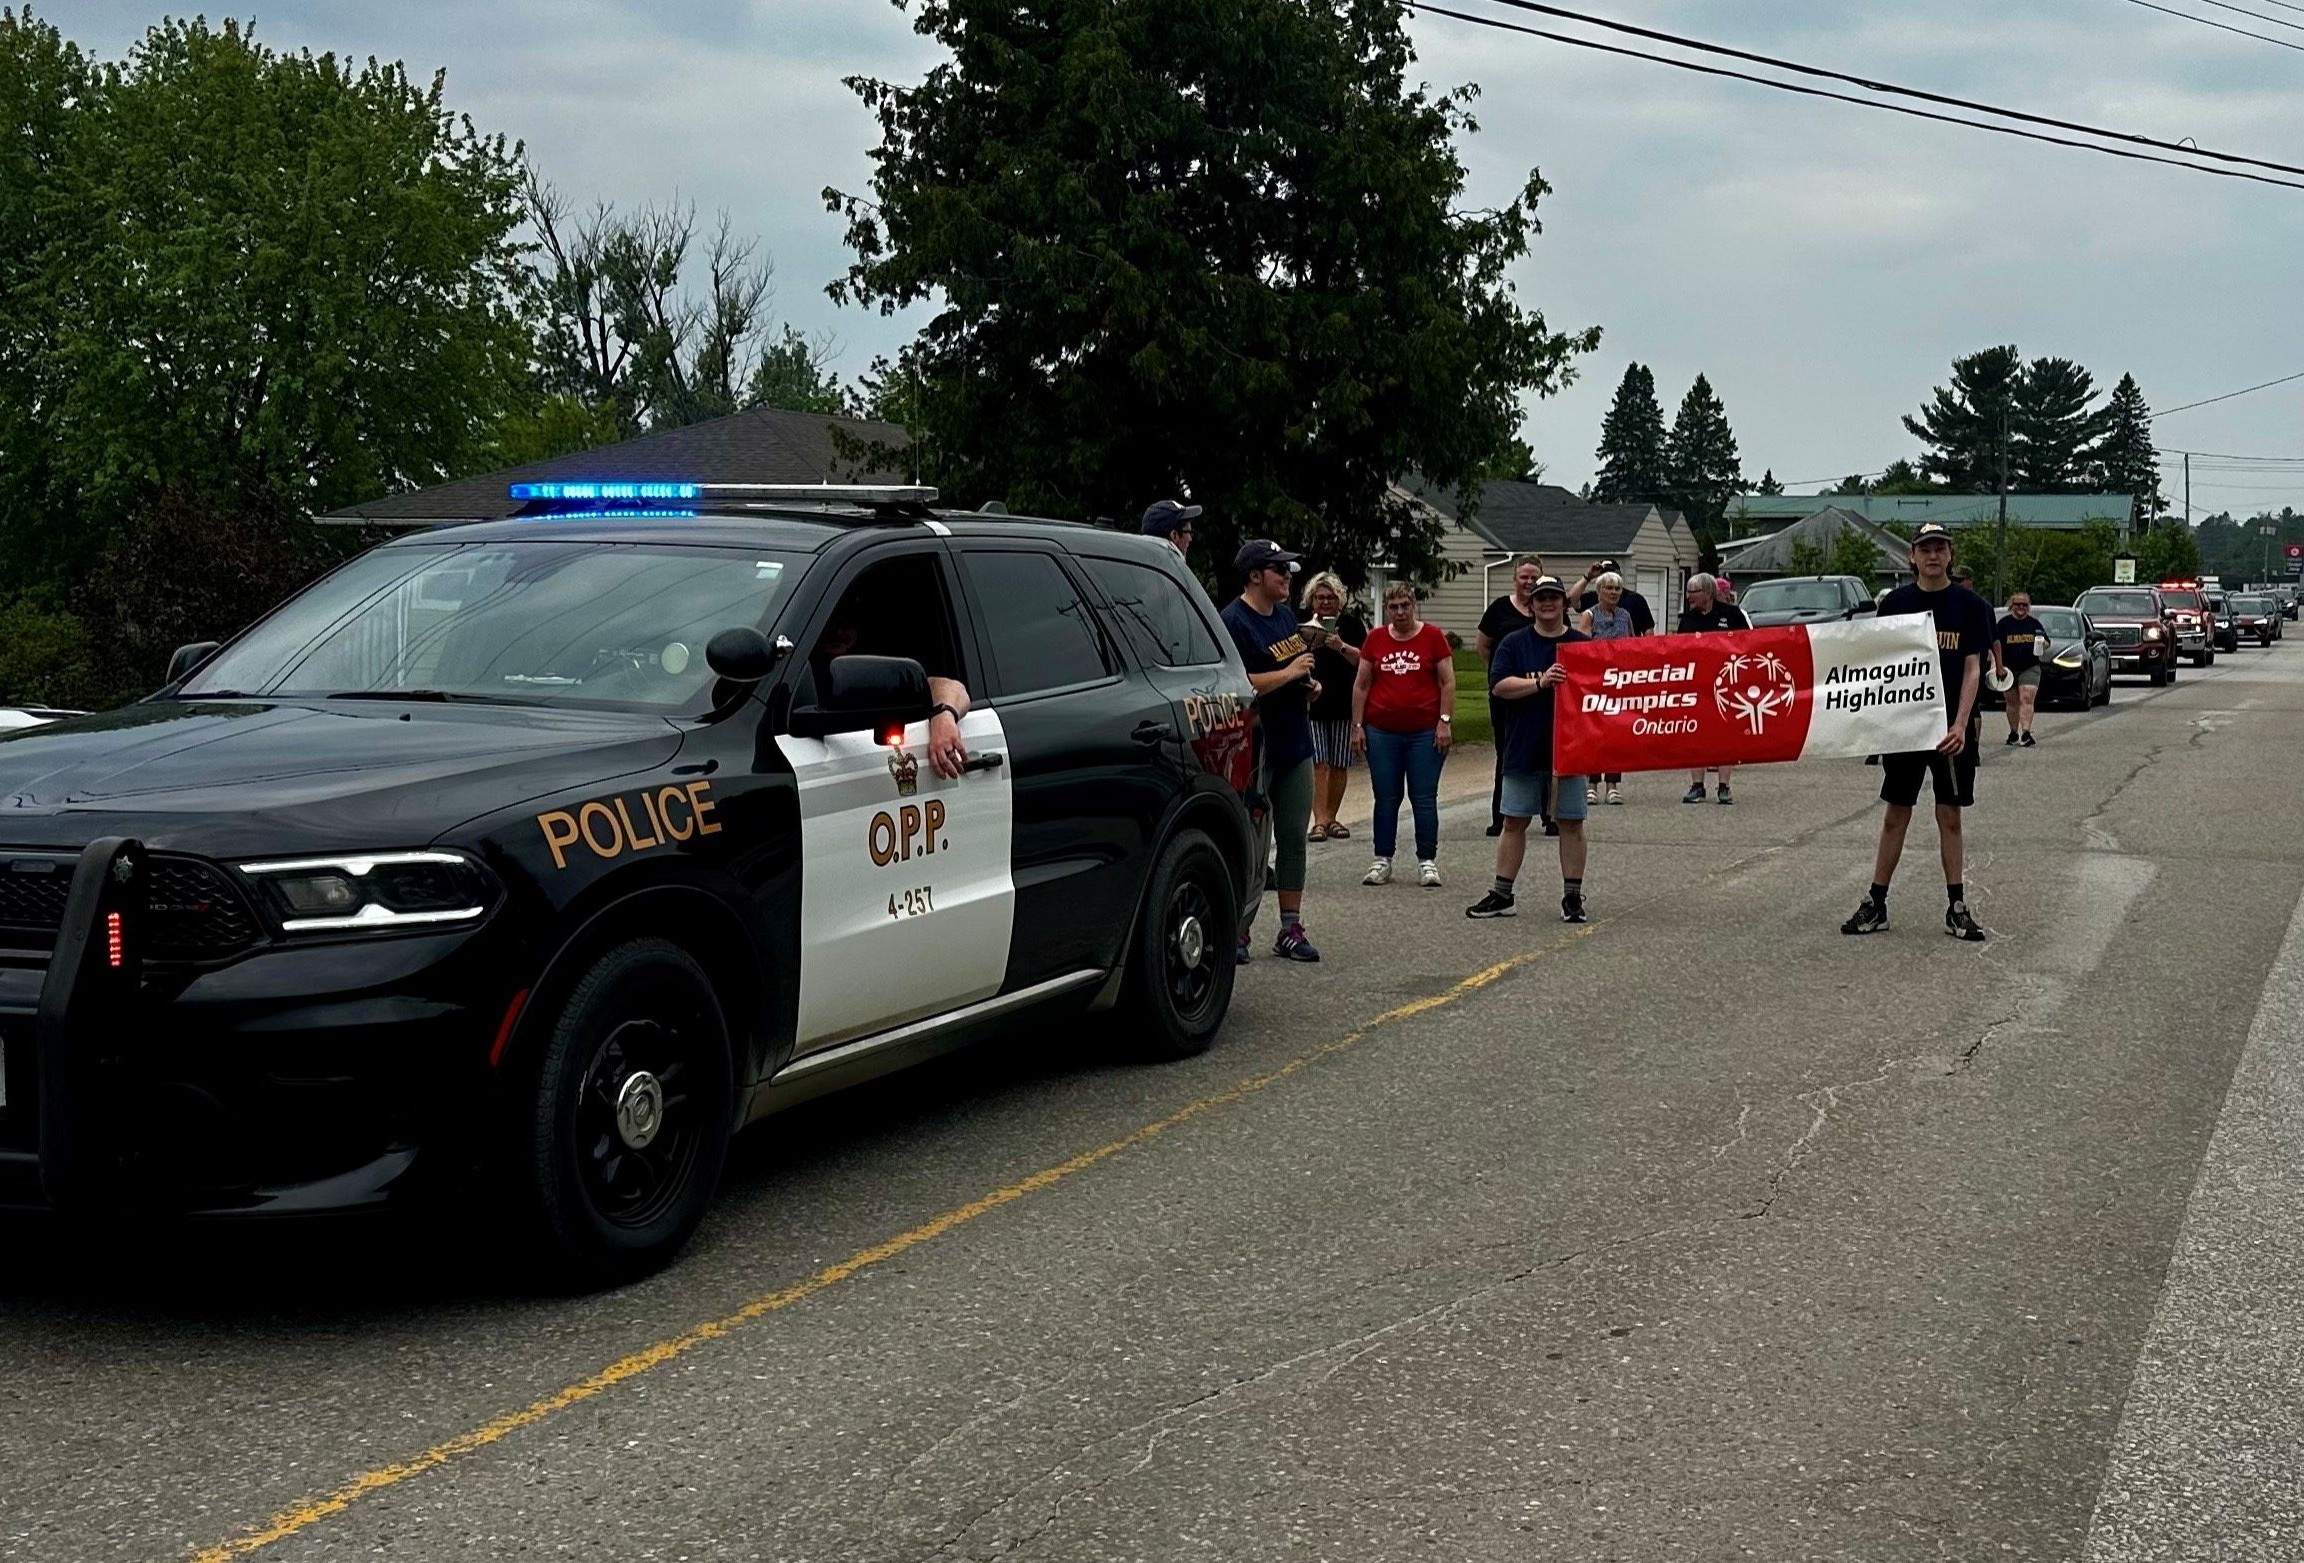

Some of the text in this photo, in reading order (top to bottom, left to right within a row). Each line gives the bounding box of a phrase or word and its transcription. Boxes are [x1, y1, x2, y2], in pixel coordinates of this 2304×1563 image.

[1381, 650, 1420, 663] CANADA
[1825, 657, 1930, 685] Almaguin
[1602, 662, 1696, 690] Special
[1581, 690, 1698, 716] Olympics
[1826, 681, 1935, 713] Highlands
[1183, 692, 1245, 735] POLICE
[1632, 715, 1698, 736] Ontario
[536, 780, 723, 870] POLICE
[868, 799, 949, 868] O.P.P.
[888, 886, 935, 920] 4-257
